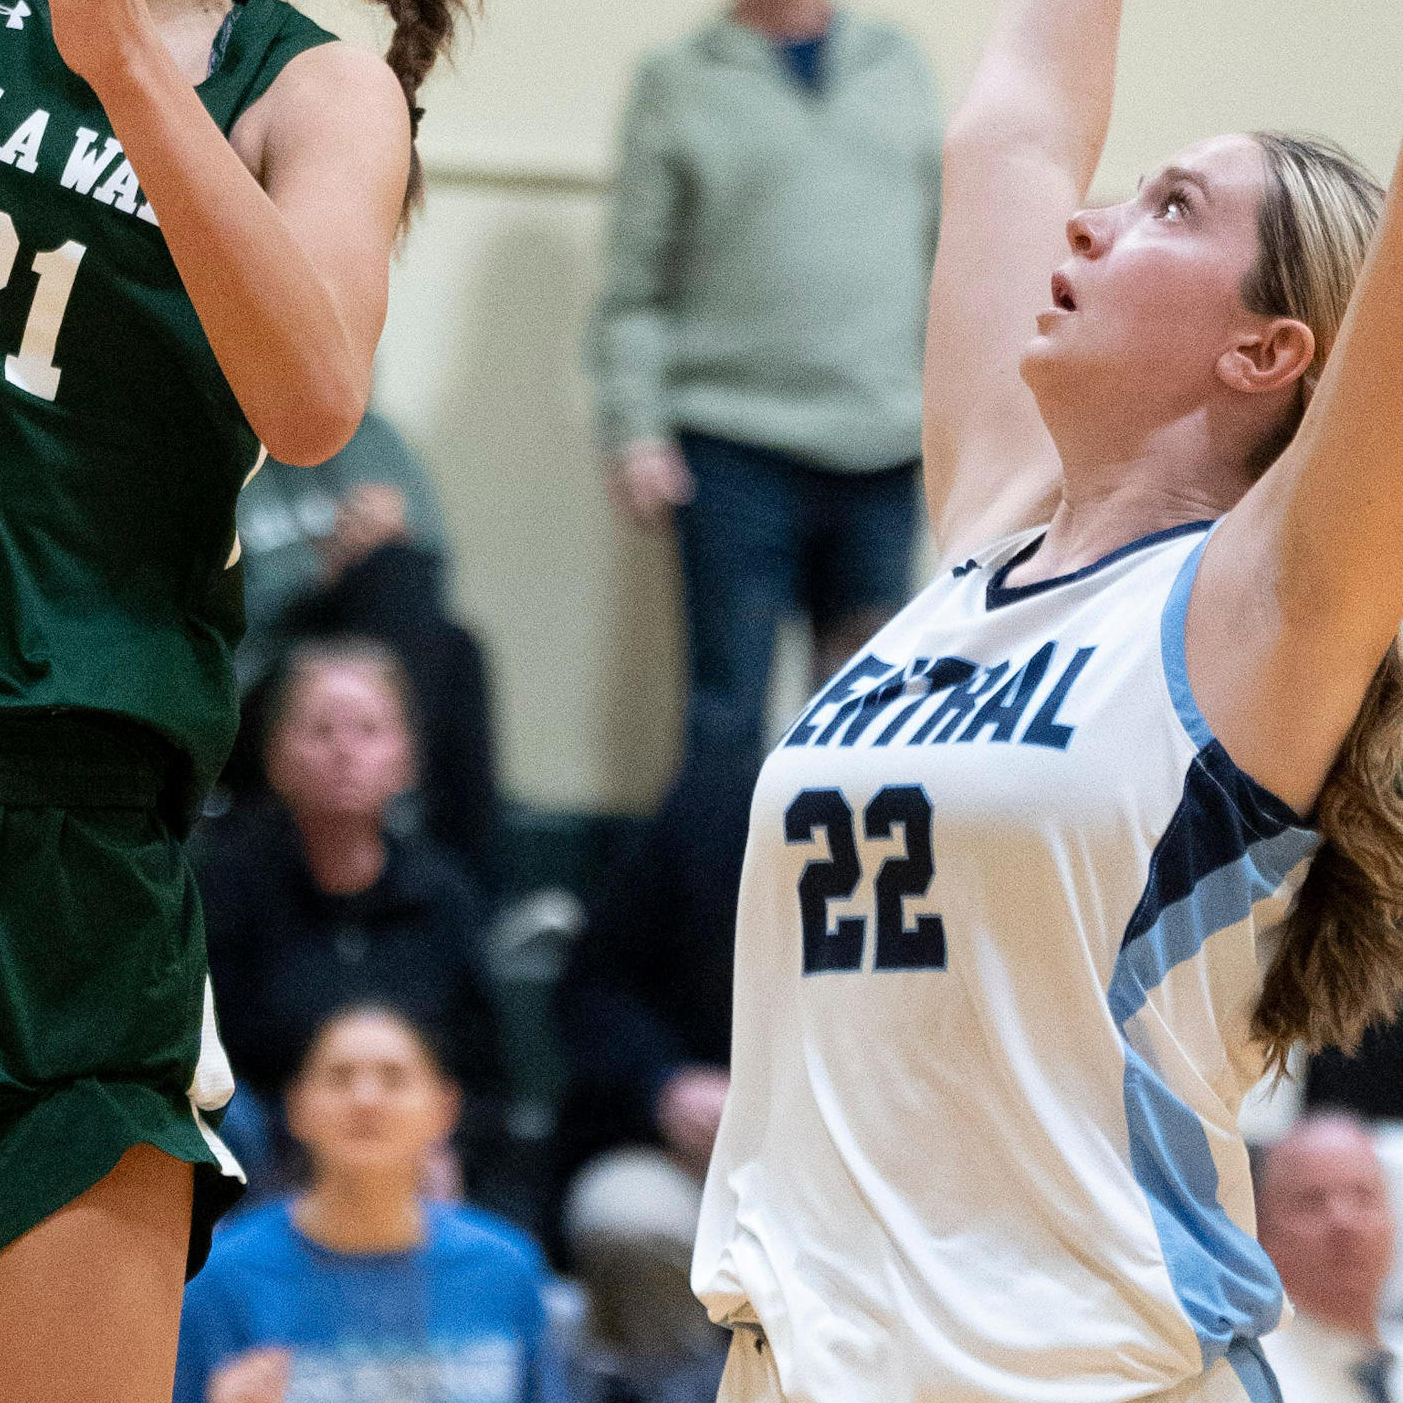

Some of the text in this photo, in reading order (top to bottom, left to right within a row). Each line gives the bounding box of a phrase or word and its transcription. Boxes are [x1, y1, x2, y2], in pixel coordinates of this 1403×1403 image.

[60, 125, 161, 228] WA
[782, 640, 1100, 752] ENTRAL
[783, 783, 948, 978] 22
